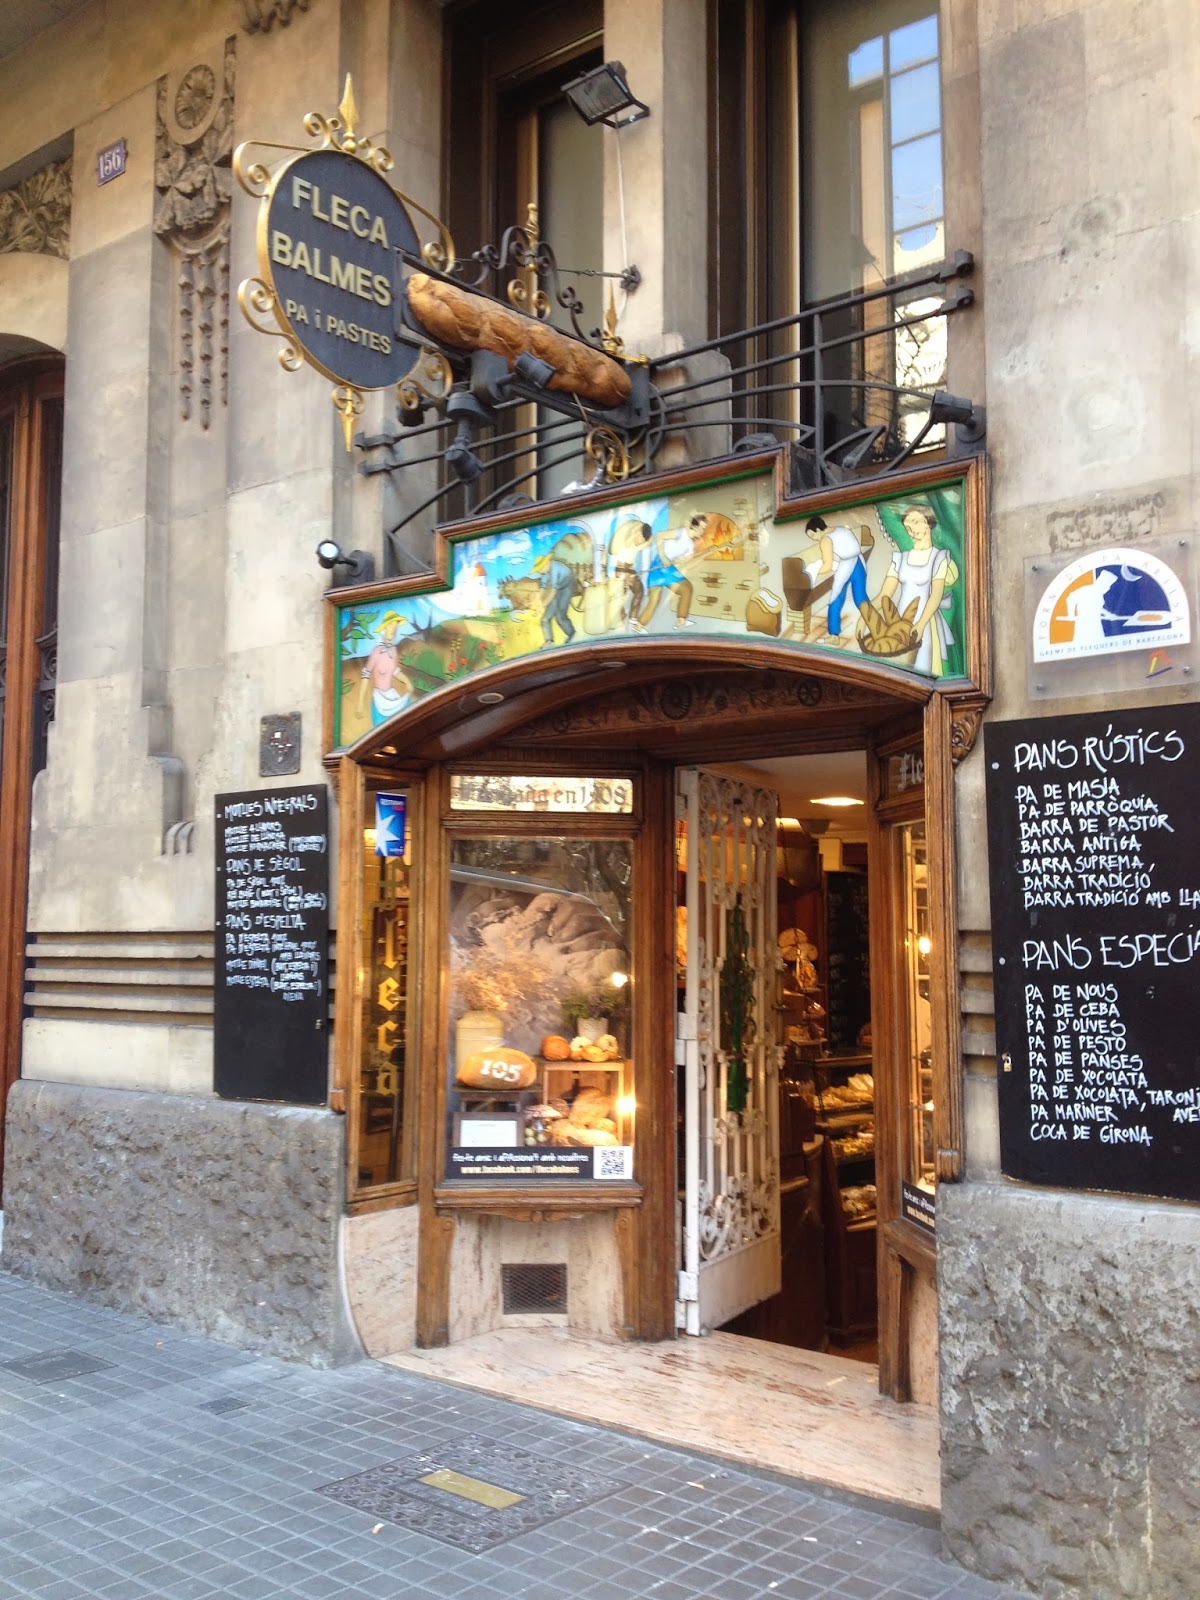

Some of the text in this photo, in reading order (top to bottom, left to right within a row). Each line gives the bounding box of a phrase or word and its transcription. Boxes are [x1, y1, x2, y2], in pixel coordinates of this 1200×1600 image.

[99, 148, 121, 178] 156
[292, 176, 390, 250] FLECA
[271, 230, 392, 307] BALMES
[286, 299, 392, 355] PA i PASTES
[1014, 739, 1078, 773] PANS
[1015, 784, 1038, 805] PA
[1043, 783, 1063, 800] DE
[1018, 804, 1041, 821] PA
[1044, 801, 1066, 816] DE
[1019, 814, 1175, 840] BARRA DE PASTOR
[1020, 836, 1076, 854] BARRA
[268, 854, 306, 872] SÈGOL
[1018, 854, 1144, 874] BARRA SUPREMA
[1021, 874, 1075, 892] BARRA
[1024, 891, 1075, 910] BARRA
[1145, 891, 1171, 909] AMB
[1178, 888, 1200, 910] LLA
[1022, 933, 1092, 970] PANS
[1024, 982, 1118, 1004] PA DE NOUS
[1026, 1002, 1120, 1020] PA DE CEBA
[1026, 1019, 1045, 1034] PA
[1028, 1034, 1126, 1056] PA DE PESTO
[480, 1059, 523, 1082] 105
[1028, 1051, 1144, 1072] PA DE PANSES
[1030, 1068, 1148, 1089] PA DE XOCOLATA
[1030, 1084, 1049, 1101] PA
[1052, 1084, 1069, 1100] DE
[1030, 1104, 1048, 1121] PA
[1173, 1107, 1200, 1124] AVE
[1030, 1122, 1068, 1141] COCA
[1072, 1126, 1091, 1140] DE
